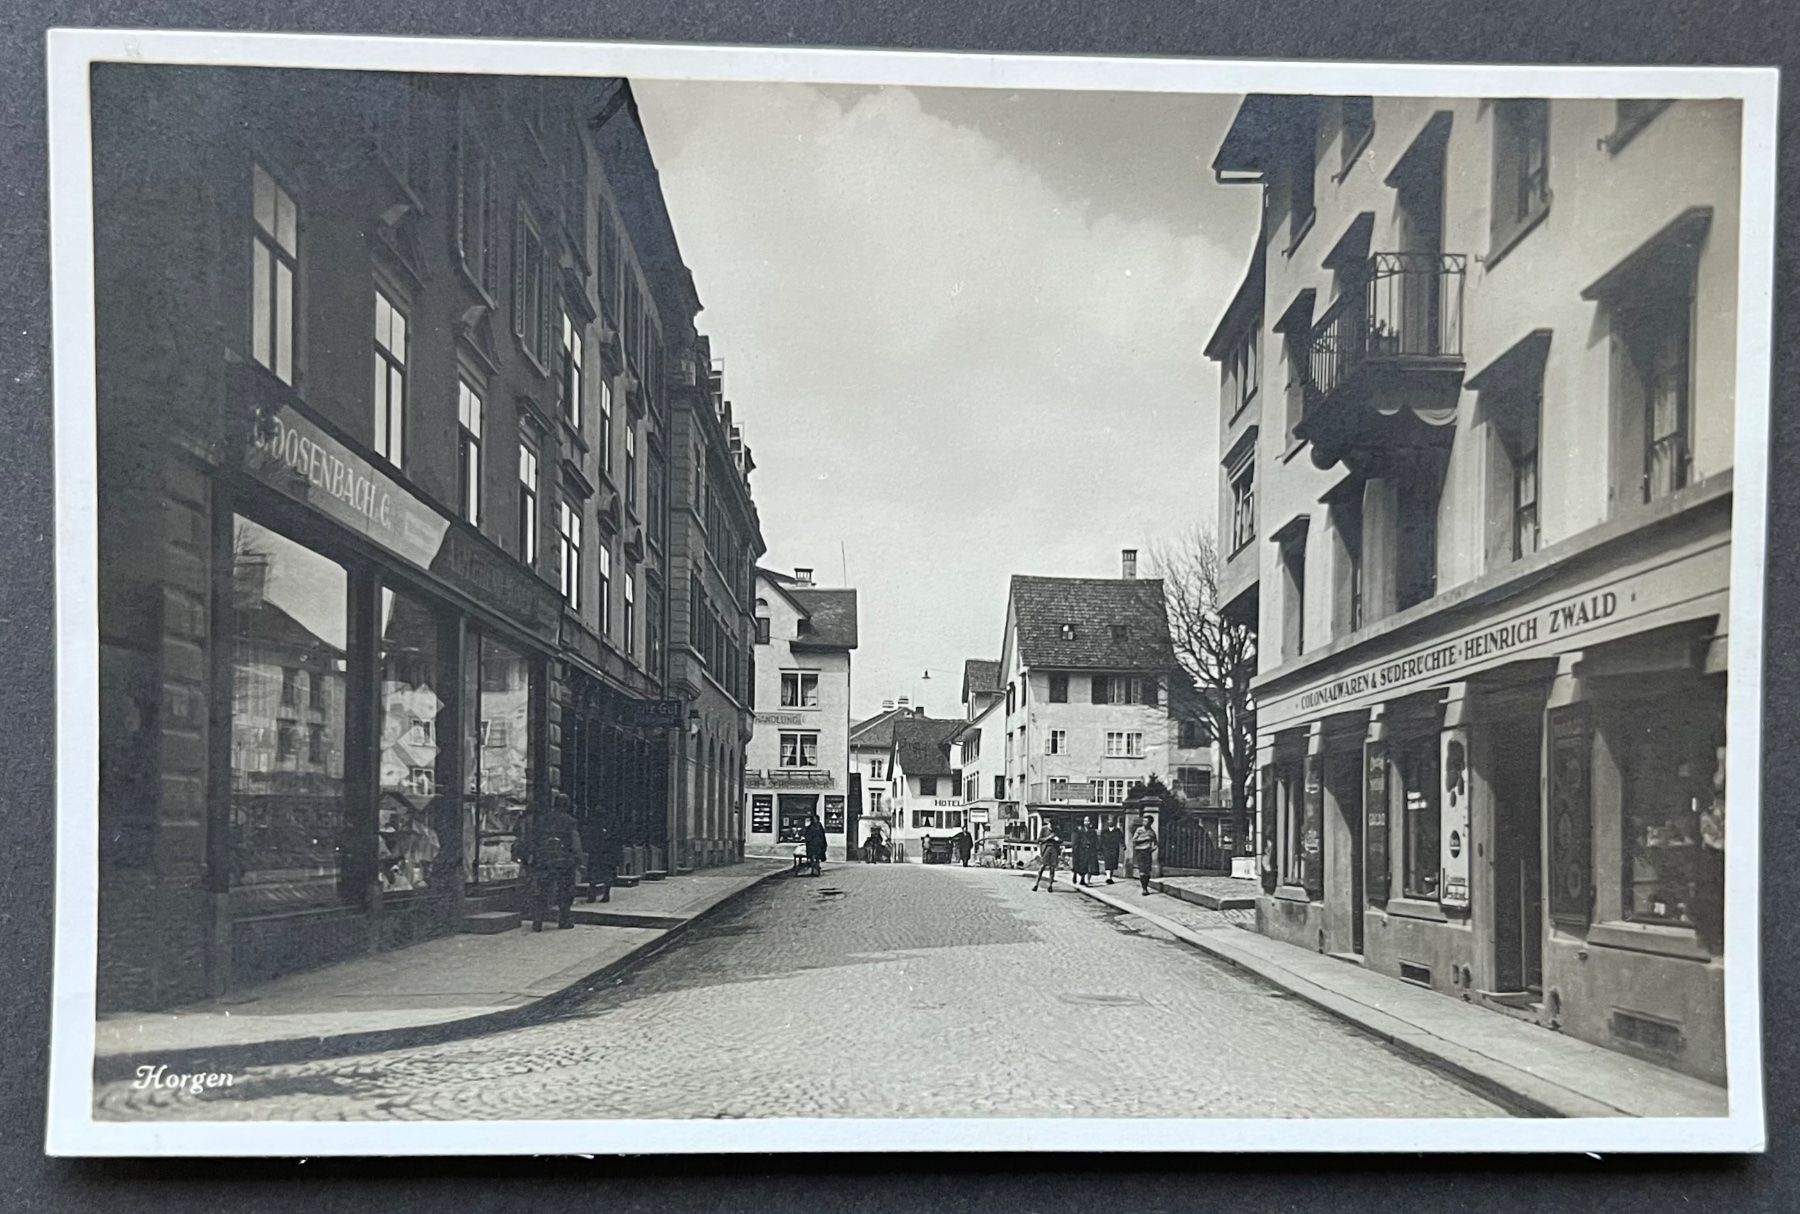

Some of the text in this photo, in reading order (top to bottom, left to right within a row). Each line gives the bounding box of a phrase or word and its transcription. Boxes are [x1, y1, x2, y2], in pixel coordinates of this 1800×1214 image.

[1301, 673, 1369, 710] COLONIALWAREN
[1371, 672, 1377, 689] &
[1464, 616, 1538, 661] HEINRICH
[1549, 592, 1617, 634] ZWALD
[934, 799, 961, 807] HOTEL
